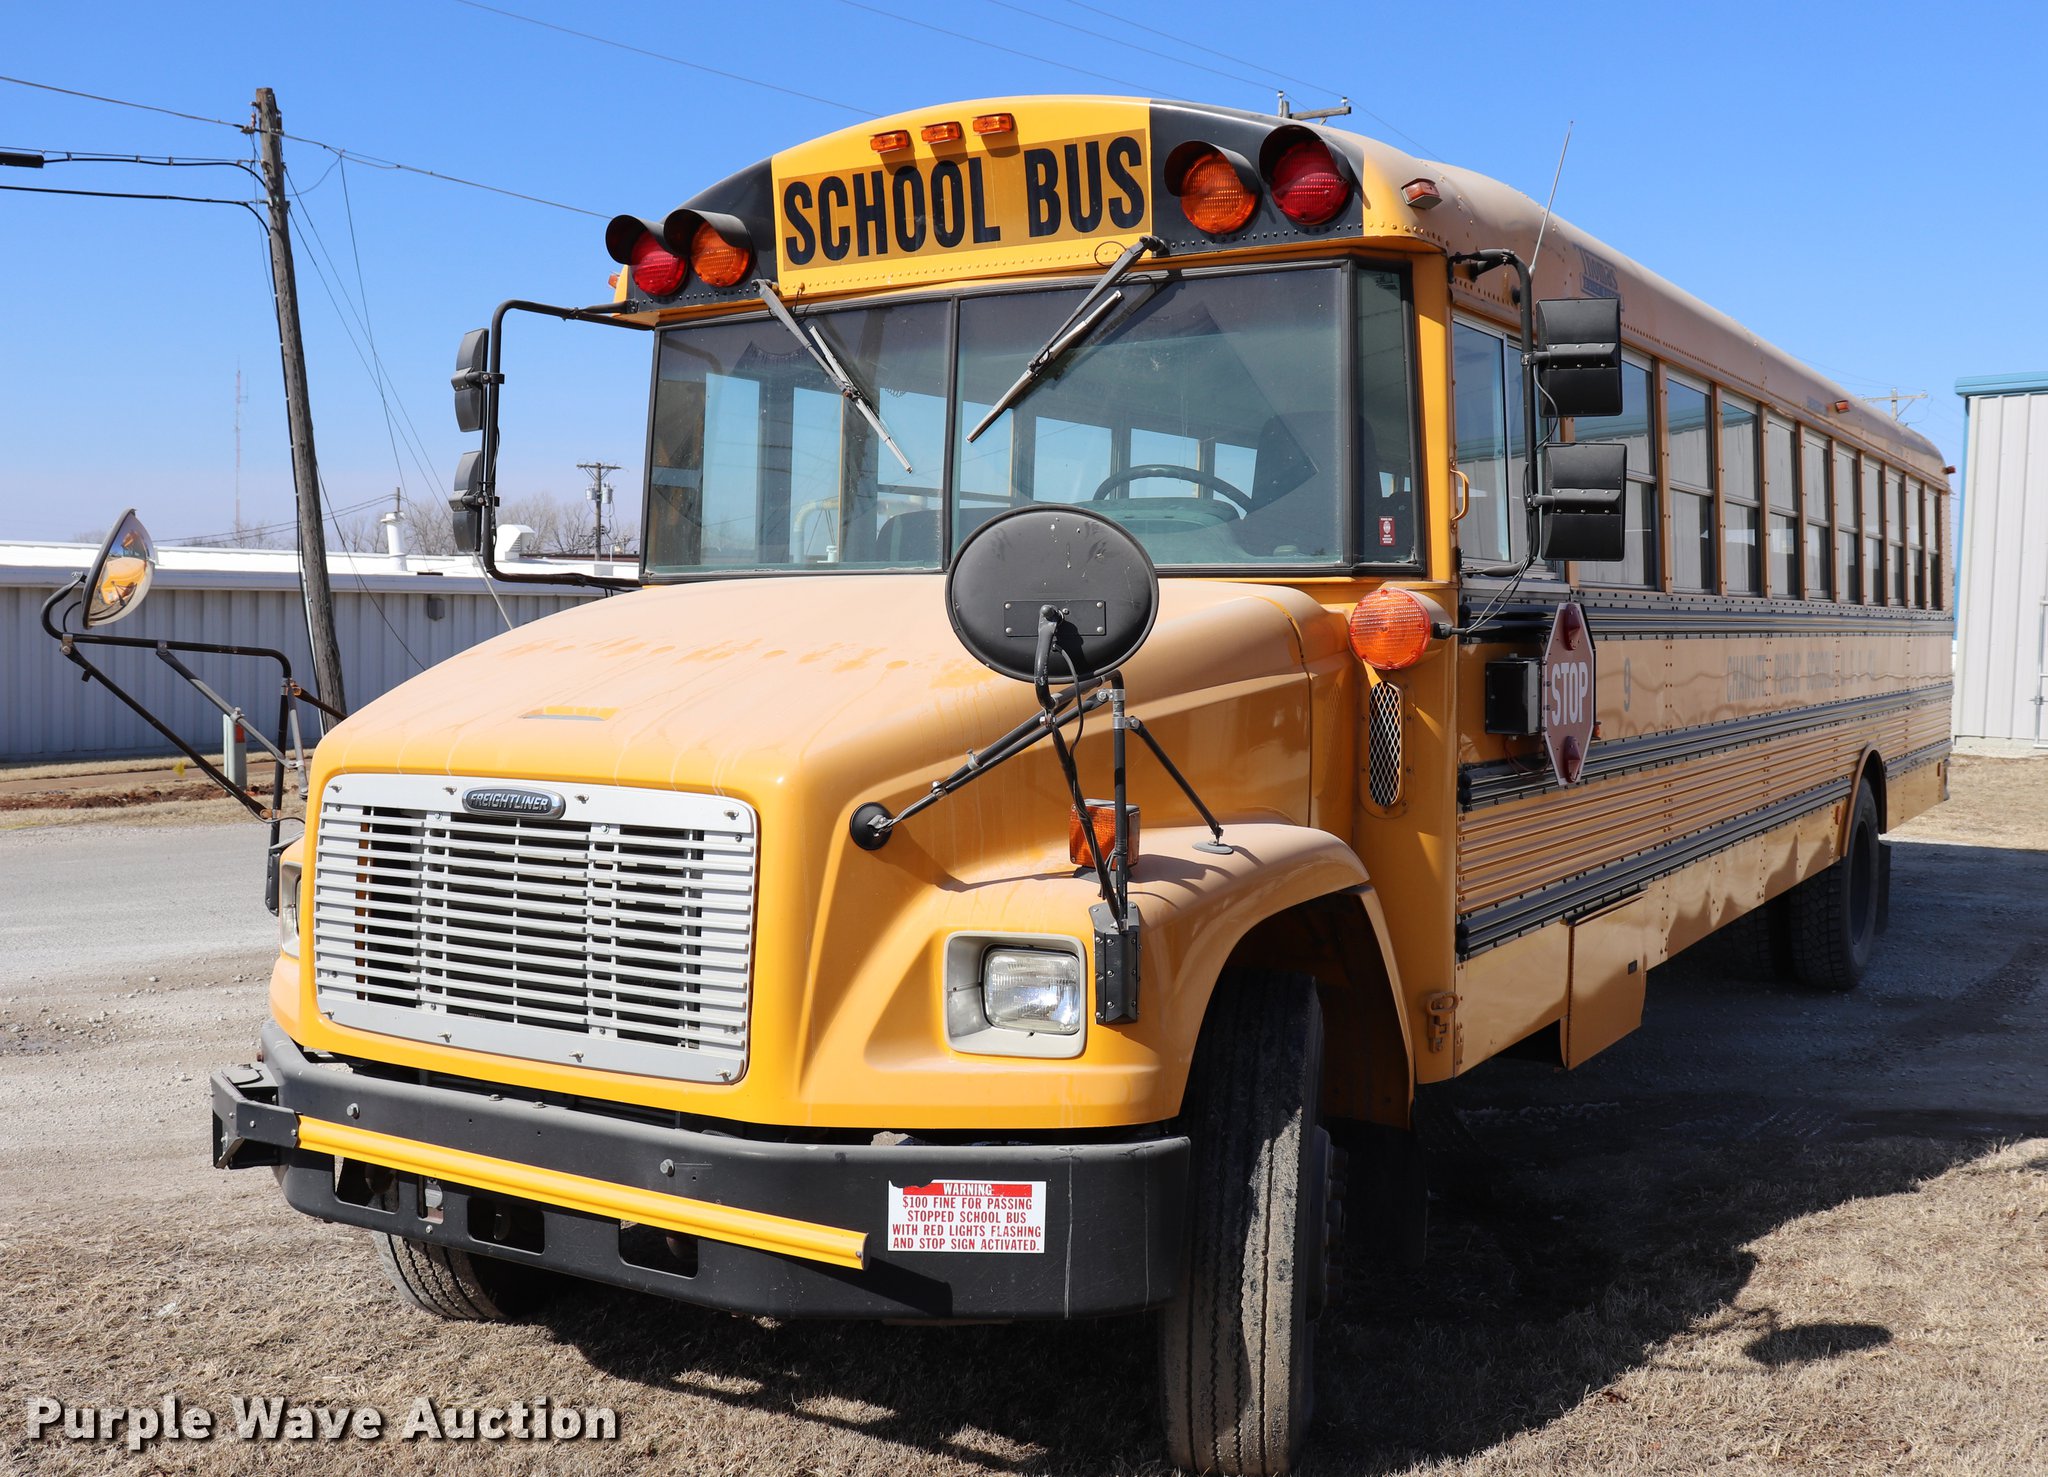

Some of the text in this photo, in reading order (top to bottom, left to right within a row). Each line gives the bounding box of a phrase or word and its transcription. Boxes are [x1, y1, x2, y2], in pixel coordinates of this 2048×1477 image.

[783, 136, 1145, 266] SCHOOL BUS
[1623, 656, 1631, 712] 9
[1551, 661, 1589, 727] STOP
[469, 793, 549, 811] FREIGHTLINER
[943, 1183, 993, 1196] WARNING
[902, 1197, 1032, 1210] $100 FINE FOR PASSING
[907, 1211, 1026, 1223] STOPPED SCHOOL BUS
[892, 1224, 1041, 1237] WITH RED LIGHTS FLASHING
[893, 1237, 1040, 1251] AND STOP SIGN ACTIVATED.
